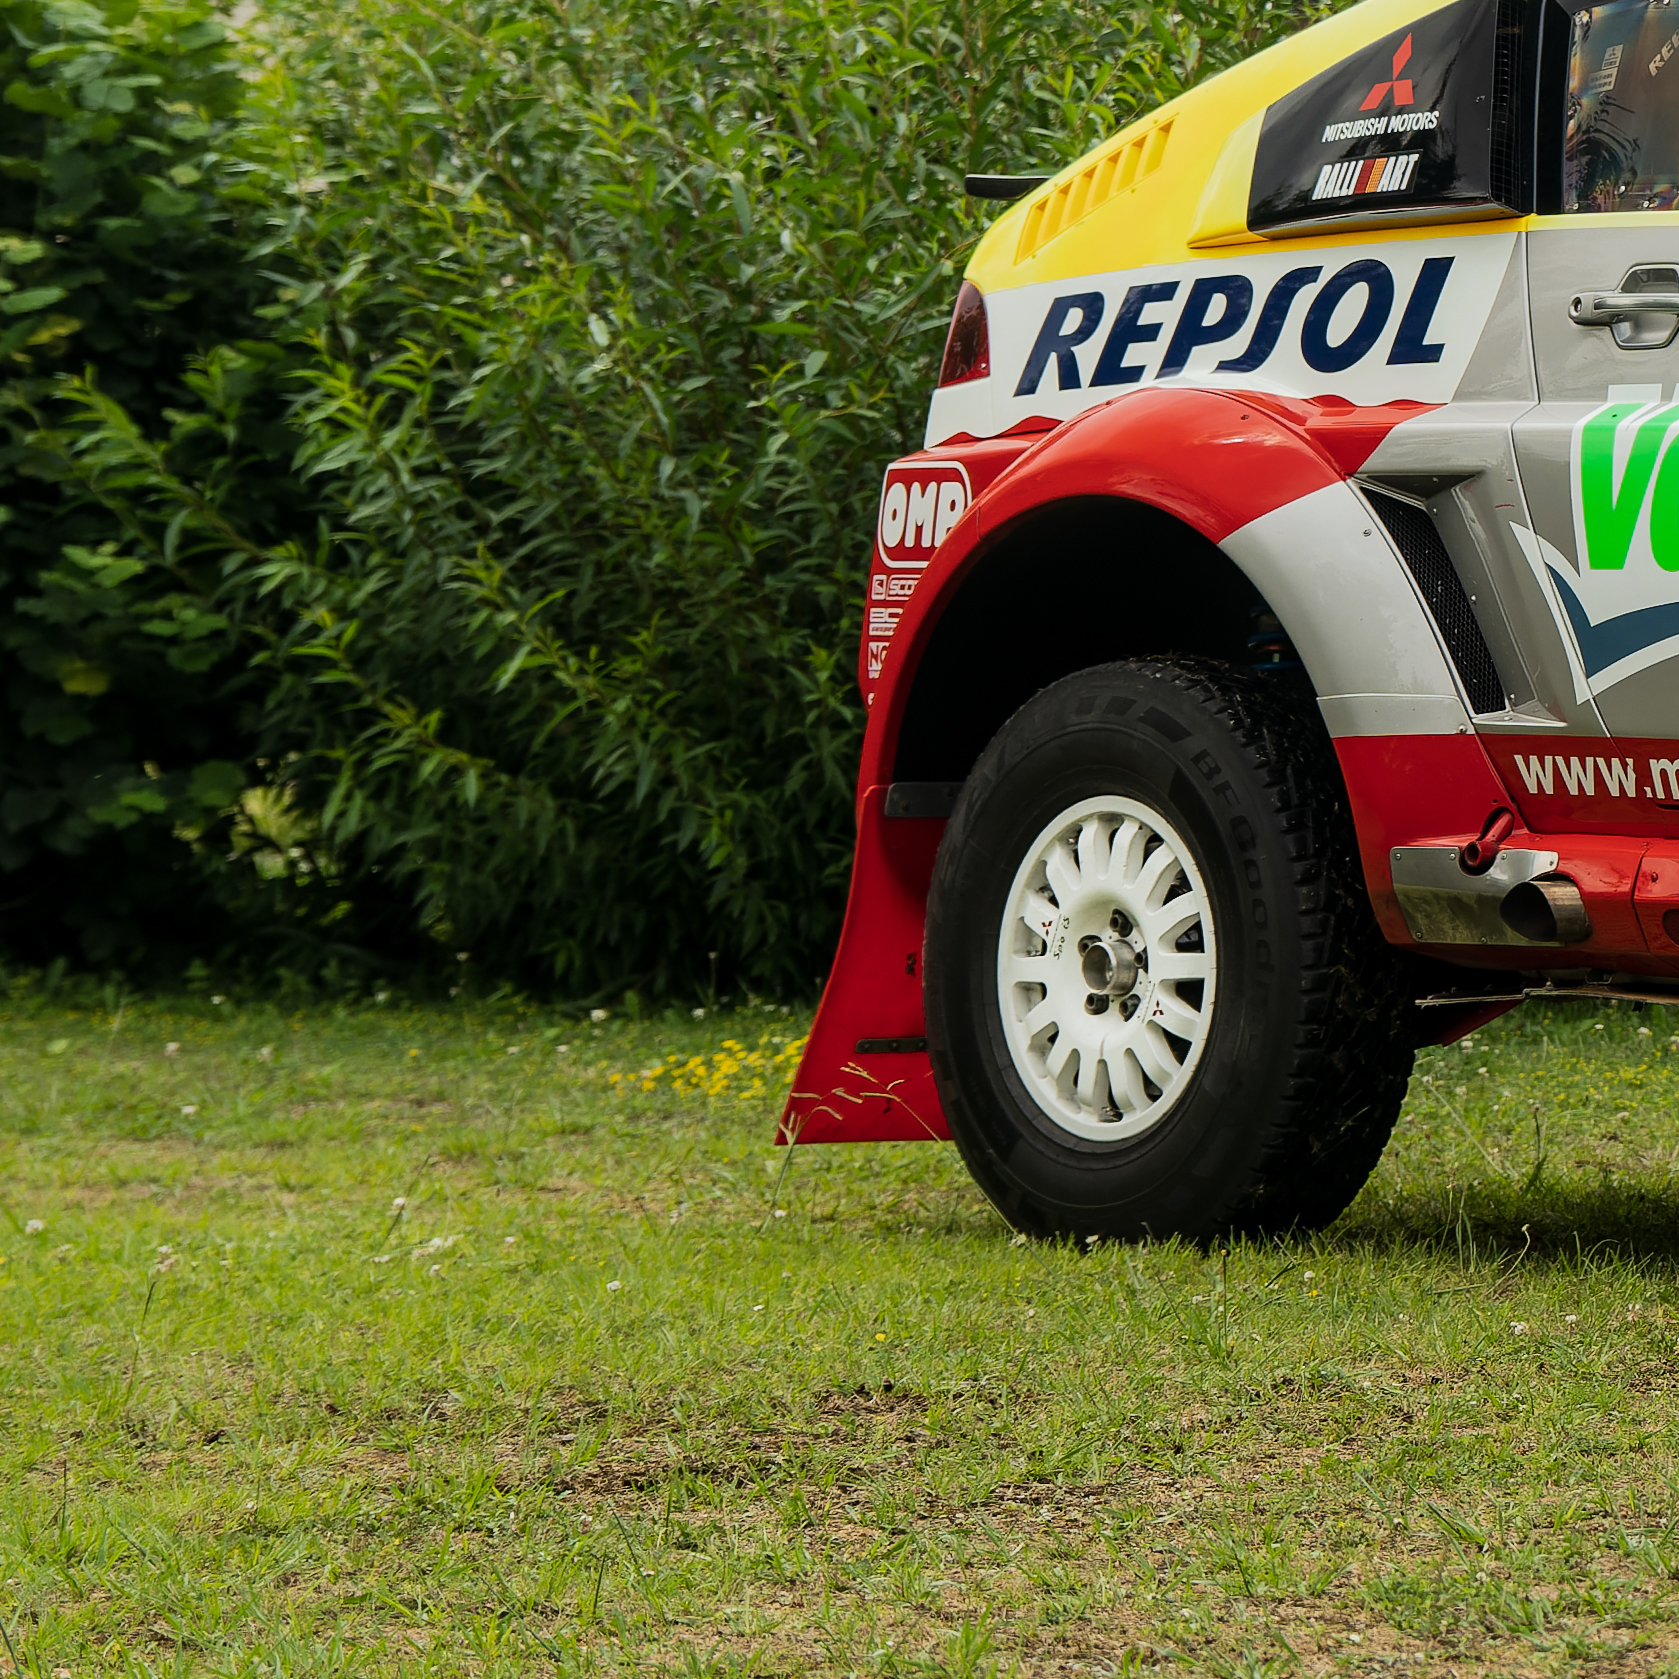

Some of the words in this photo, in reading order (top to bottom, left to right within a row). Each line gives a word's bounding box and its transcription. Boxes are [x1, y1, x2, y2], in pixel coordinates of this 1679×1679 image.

[1321, 116, 1388, 143] MITSUBISHI
[1387, 111, 1440, 133] MOTORS
[1013, 256, 1456, 397] REPSOL
[882, 481, 966, 549] OMP
